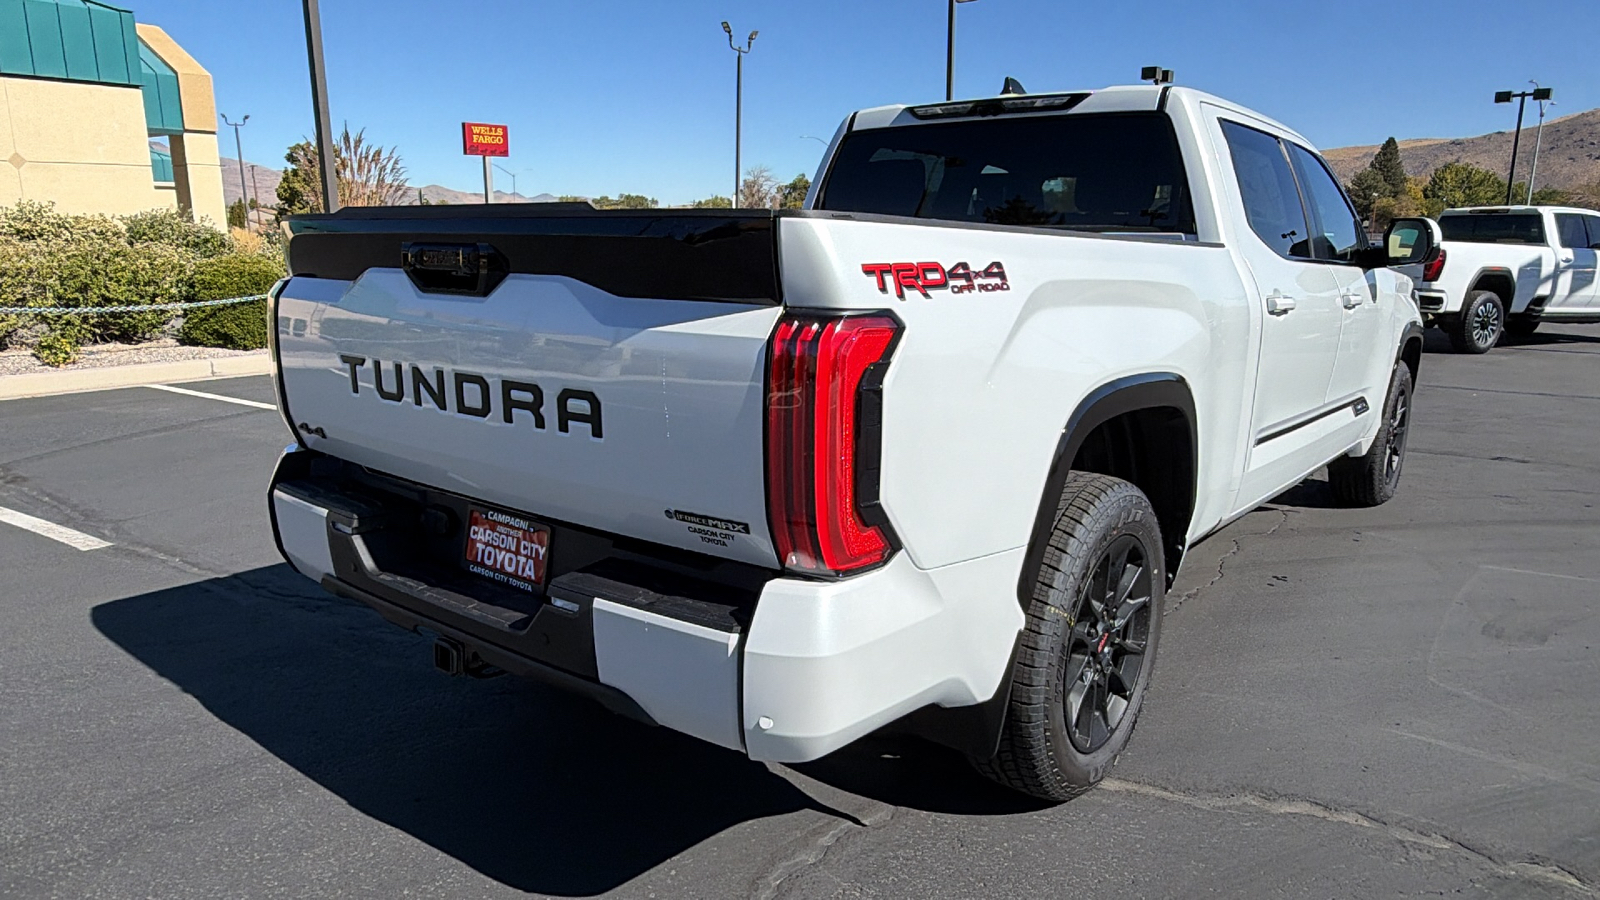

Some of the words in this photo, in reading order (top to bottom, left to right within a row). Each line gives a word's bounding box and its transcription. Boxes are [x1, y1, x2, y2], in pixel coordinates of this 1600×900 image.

[471, 126, 503, 136] WELLS
[472, 134, 504, 144] FARGO
[861, 262, 949, 301] TRD
[951, 285, 976, 294] OFF
[978, 283, 1010, 293] ROAD
[339, 353, 604, 439] TUNDRA
[487, 511, 528, 530] CAMPAGNI
[470, 525, 517, 551] CARSON
[520, 540, 546, 560] CITY
[687, 526, 718, 538] CARSON
[719, 532, 735, 541] CITY
[700, 536, 728, 547] TOYOTA
[476, 543, 535, 580] TOYOTA
[469, 564, 494, 579] CARSON
[494, 573, 508, 583] CITY
[509, 577, 532, 592] TOYOTA
